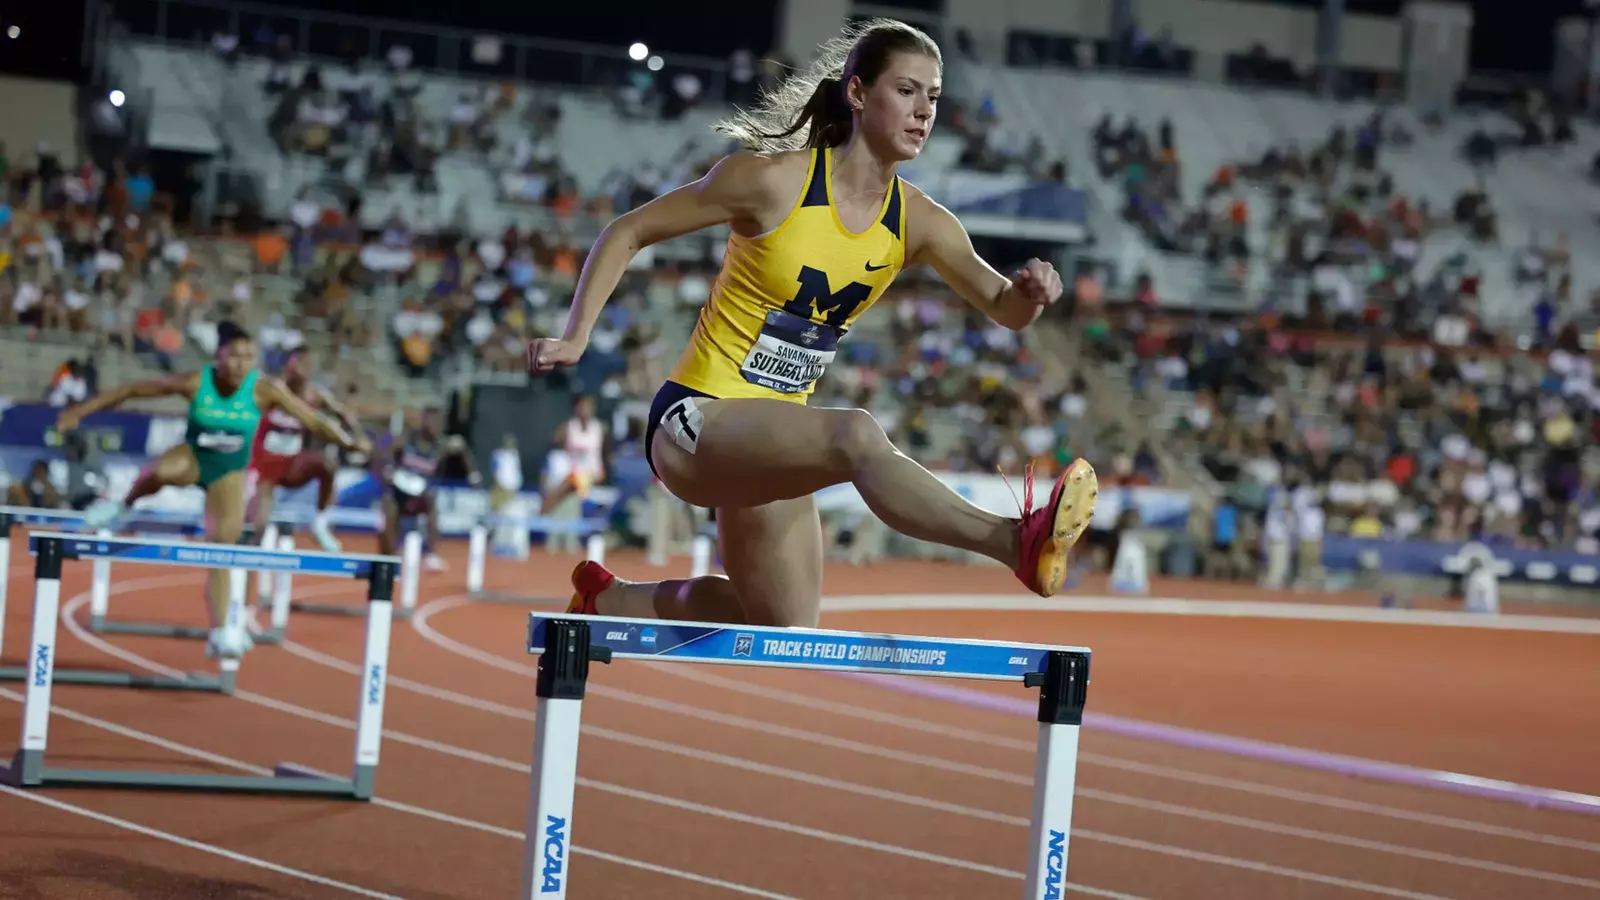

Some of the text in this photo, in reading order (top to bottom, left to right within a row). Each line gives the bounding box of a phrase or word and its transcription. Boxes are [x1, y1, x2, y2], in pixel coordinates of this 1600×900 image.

[782, 265, 873, 325] M
[750, 352, 822, 381] SUTHERLAND
[776, 345, 822, 364] SAVANNAH
[606, 631, 629, 641] GILL
[763, 639, 947, 666] TRACK & FIELD CHAMPIONSHIPS
[1008, 656, 1028, 665] GILL
[541, 814, 566, 893] NCAA
[1044, 829, 1065, 900] NCAA
